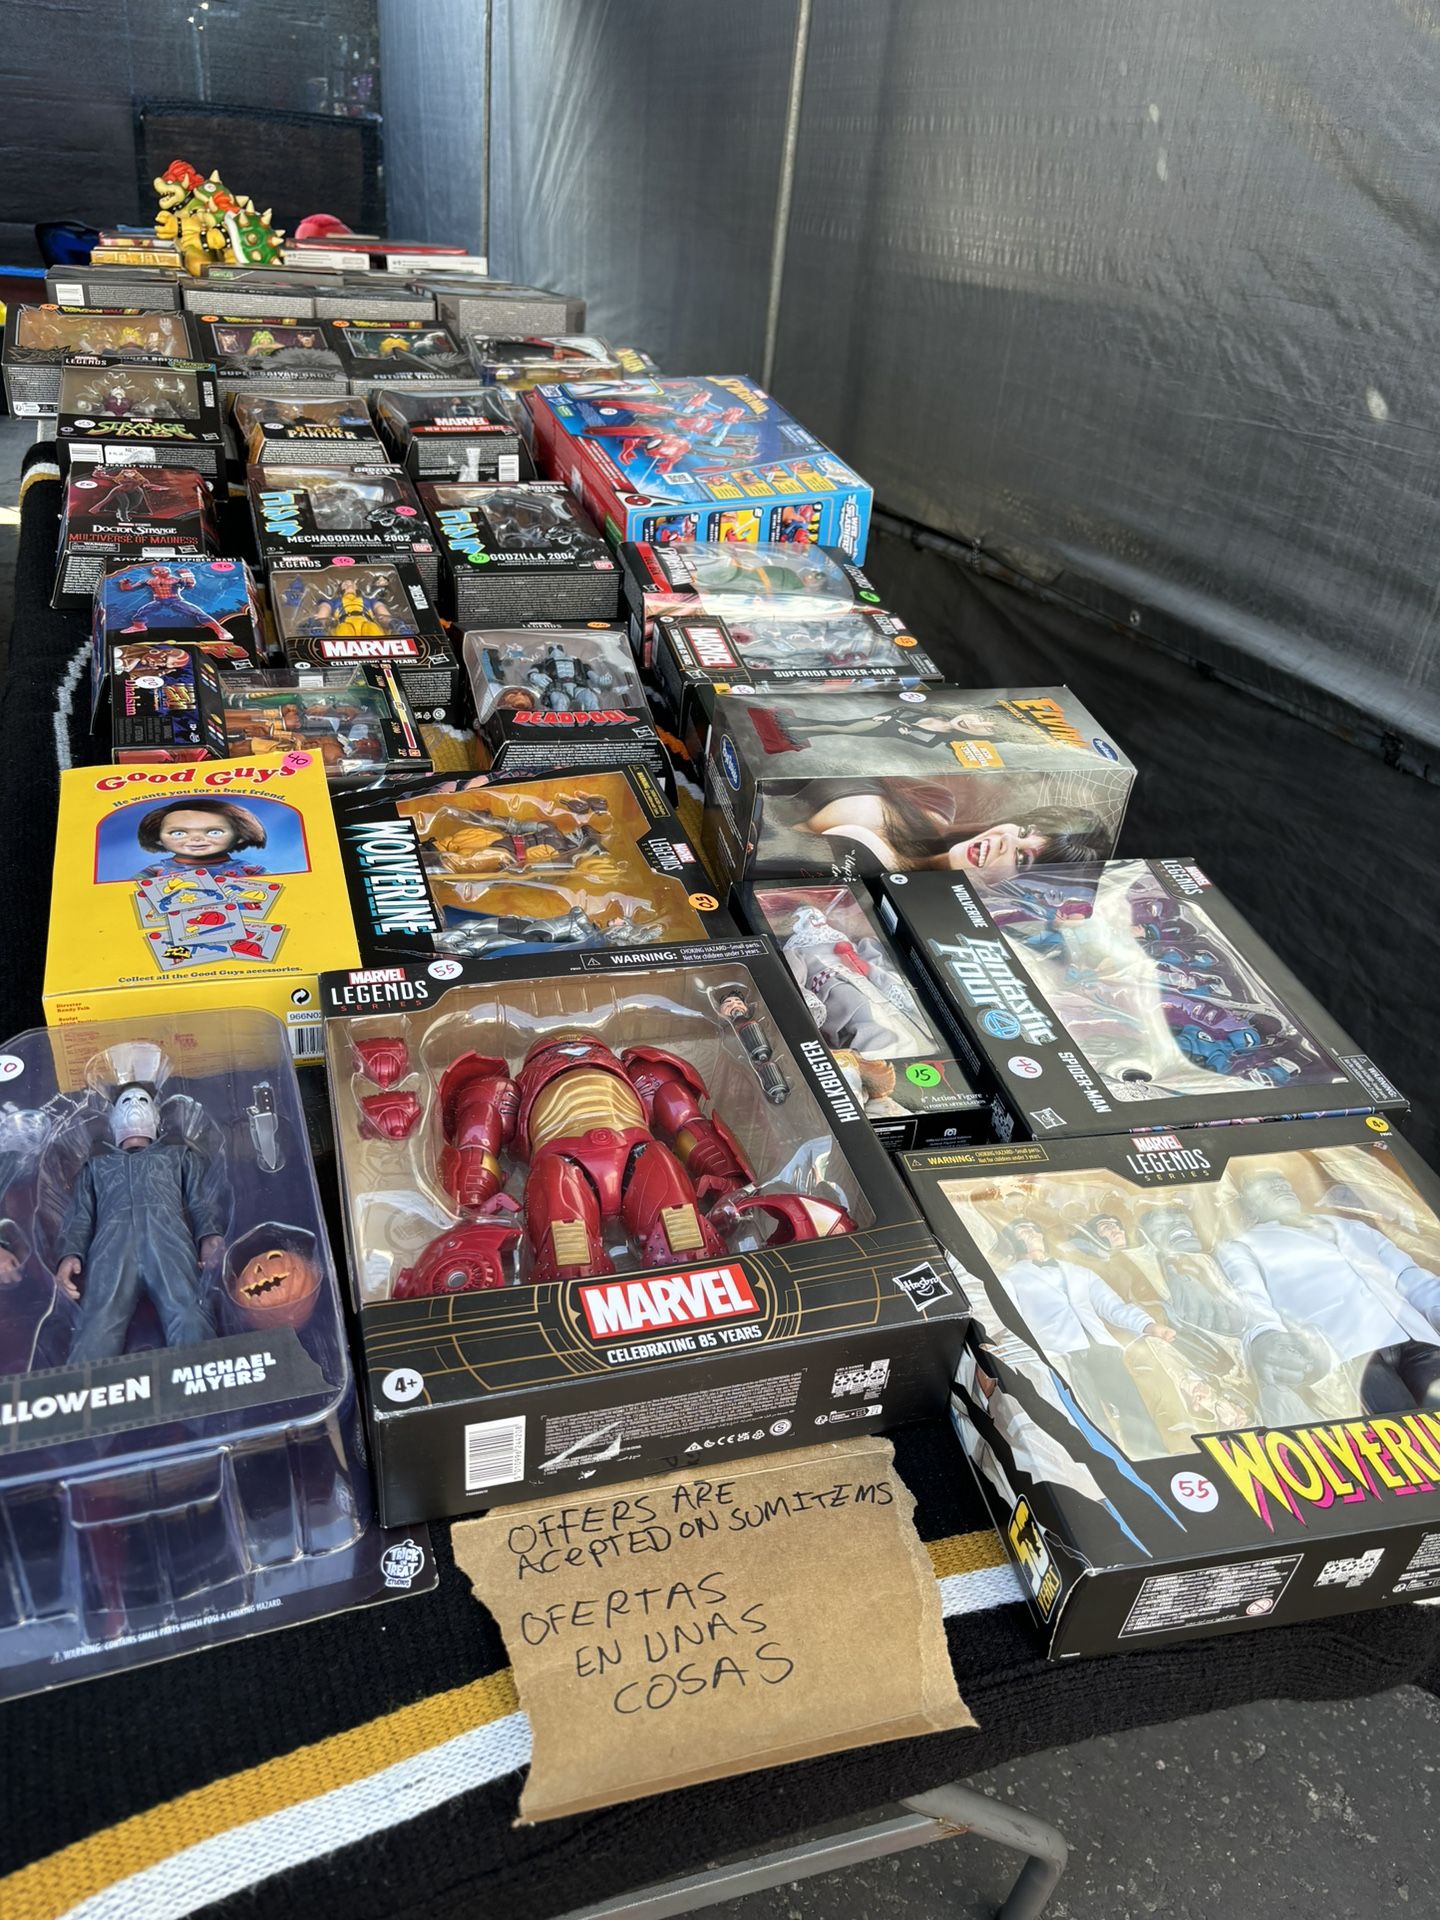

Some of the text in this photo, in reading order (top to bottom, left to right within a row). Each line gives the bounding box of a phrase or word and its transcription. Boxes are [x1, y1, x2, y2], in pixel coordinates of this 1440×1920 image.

[65, 358, 107, 366] LEGENDS
[434, 416, 490, 426] MARVEL
[115, 428, 174, 438] TALES
[287, 429, 358, 440] PANTHER
[295, 426, 344, 434] BLACK
[92, 524, 177, 535] DOCTOR STRANGE
[69, 533, 199, 545] MULTIVERSE OF MADNESS
[287, 533, 412, 544] MECHAGODZILLA 2002
[272, 560, 323, 568] LEGENDS
[490, 552, 576, 561] GODZILLA 2004
[324, 639, 417, 657] MARVEL
[685, 627, 736, 668] MARVEL
[773, 667, 897, 678] SUPERIOR SPIDER-MAN
[124, 679, 141, 717] Dhalsim
[512, 710, 640, 727] DEADPOOL
[287, 752, 309, 766] 40
[96, 765, 297, 792] Good Guys
[112, 799, 129, 809] He
[131, 791, 167, 802] wants
[168, 789, 191, 798] you
[193, 787, 212, 795] for
[223, 786, 248, 794] best
[249, 788, 287, 801] friend.
[648, 837, 684, 872] LEGENDS
[352, 820, 435, 936] WOLVERINE
[1160, 859, 1204, 895] LEGENDS
[694, 895, 713, 909] 50
[951, 884, 989, 929] WOLVERINE
[610, 950, 678, 965] WARNING:
[702, 952, 724, 960] children
[118, 974, 155, 983] Collect
[191, 970, 217, 978] Good
[219, 969, 245, 978] Guys
[246, 966, 303, 975] accessories.
[350, 968, 405, 985] MARVEL
[434, 963, 456, 977] 55
[927, 938, 1005, 1012] Four
[331, 980, 429, 1006] LEGENDS
[955, 933, 1059, 1047] Fantastic
[340, 1000, 422, 1012] SERIES
[800, 1040, 860, 1123] HULKBUSTER
[914, 1068, 932, 1083] 15
[1058, 1051, 1112, 1114] SPIDER-MAN
[931, 1094, 956, 1103] Action
[957, 1091, 983, 1102] Figure
[1133, 1135, 1183, 1151] MARVEL
[927, 1154, 976, 1165] WARNING:
[1126, 1148, 1212, 1175] LEGENDS
[1144, 1170, 1211, 1182] SERIES
[900, 1273, 940, 1293] Hasbro
[583, 1268, 754, 1336] MARVEL
[607, 1325, 763, 1365] CELEBRATING 85 YEARS
[172, 1352, 277, 1385] MICHAEL
[184, 1366, 267, 1396] MYERS
[394, 1376, 418, 1393] 4+
[0, 1376, 152, 1426] LLOWEEN
[1178, 1479, 1212, 1499] 55
[508, 1481, 736, 1556] OFFERS ARE
[679, 1516, 719, 1539] ON
[389, 1546, 420, 1562] TRICK
[385, 1561, 419, 1577] TREAT
[521, 1571, 728, 1645] OFERTAS
[63, 1642, 103, 1659] WARNING:
[104, 1636, 137, 1651] CONTAINS
[138, 1630, 159, 1642] SMALL
[159, 1624, 180, 1637] PARTS
[180, 1619, 203, 1632] WHICH
[203, 1615, 220, 1626] POSE
[226, 1605, 256, 1619] CHOKING
[256, 1598, 284, 1613] HAZARD.
[575, 1603, 767, 1678] EN UNAS
[613, 1641, 795, 1714] COSAS
